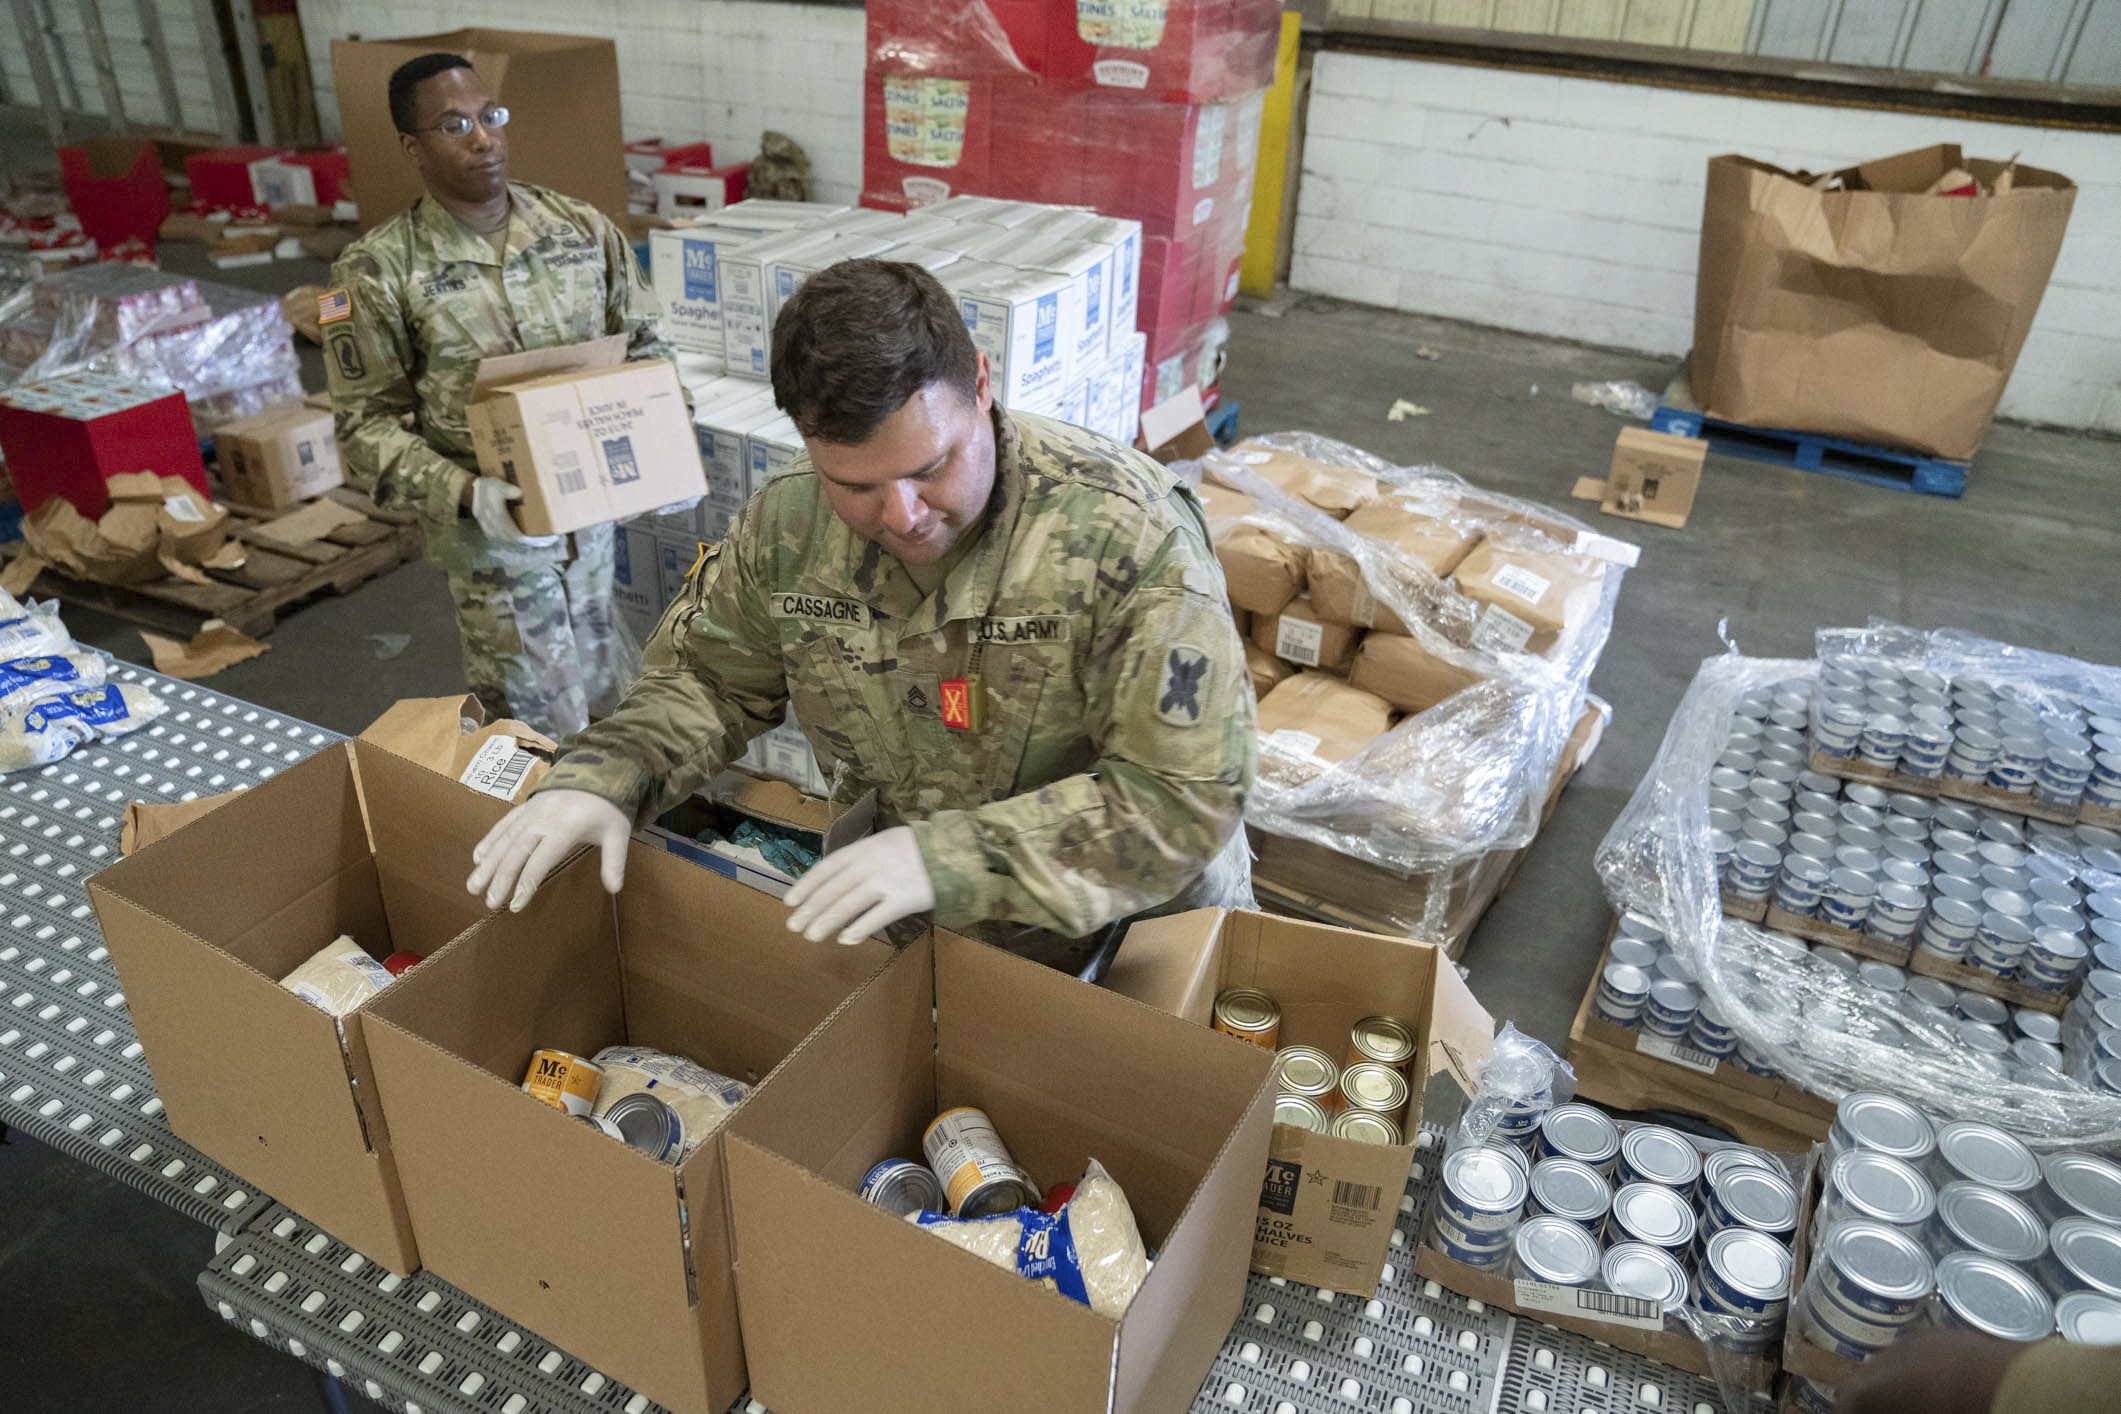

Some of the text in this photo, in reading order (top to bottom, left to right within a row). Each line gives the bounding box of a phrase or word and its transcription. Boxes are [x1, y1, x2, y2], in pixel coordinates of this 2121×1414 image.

[671, 302, 720, 321] Spaghe
[783, 596, 861, 622] CASSAGNE
[1014, 620, 1059, 641] ARMY
[480, 758, 506, 785] Rice
[537, 1058, 567, 1078] Mc
[535, 1074, 562, 1089] TRADER
[1262, 1182, 1292, 1196] ADER
[1273, 1220, 1294, 1231] OZ
[1256, 1234, 1289, 1248] UICE
[1258, 1226, 1313, 1245] HALVES
